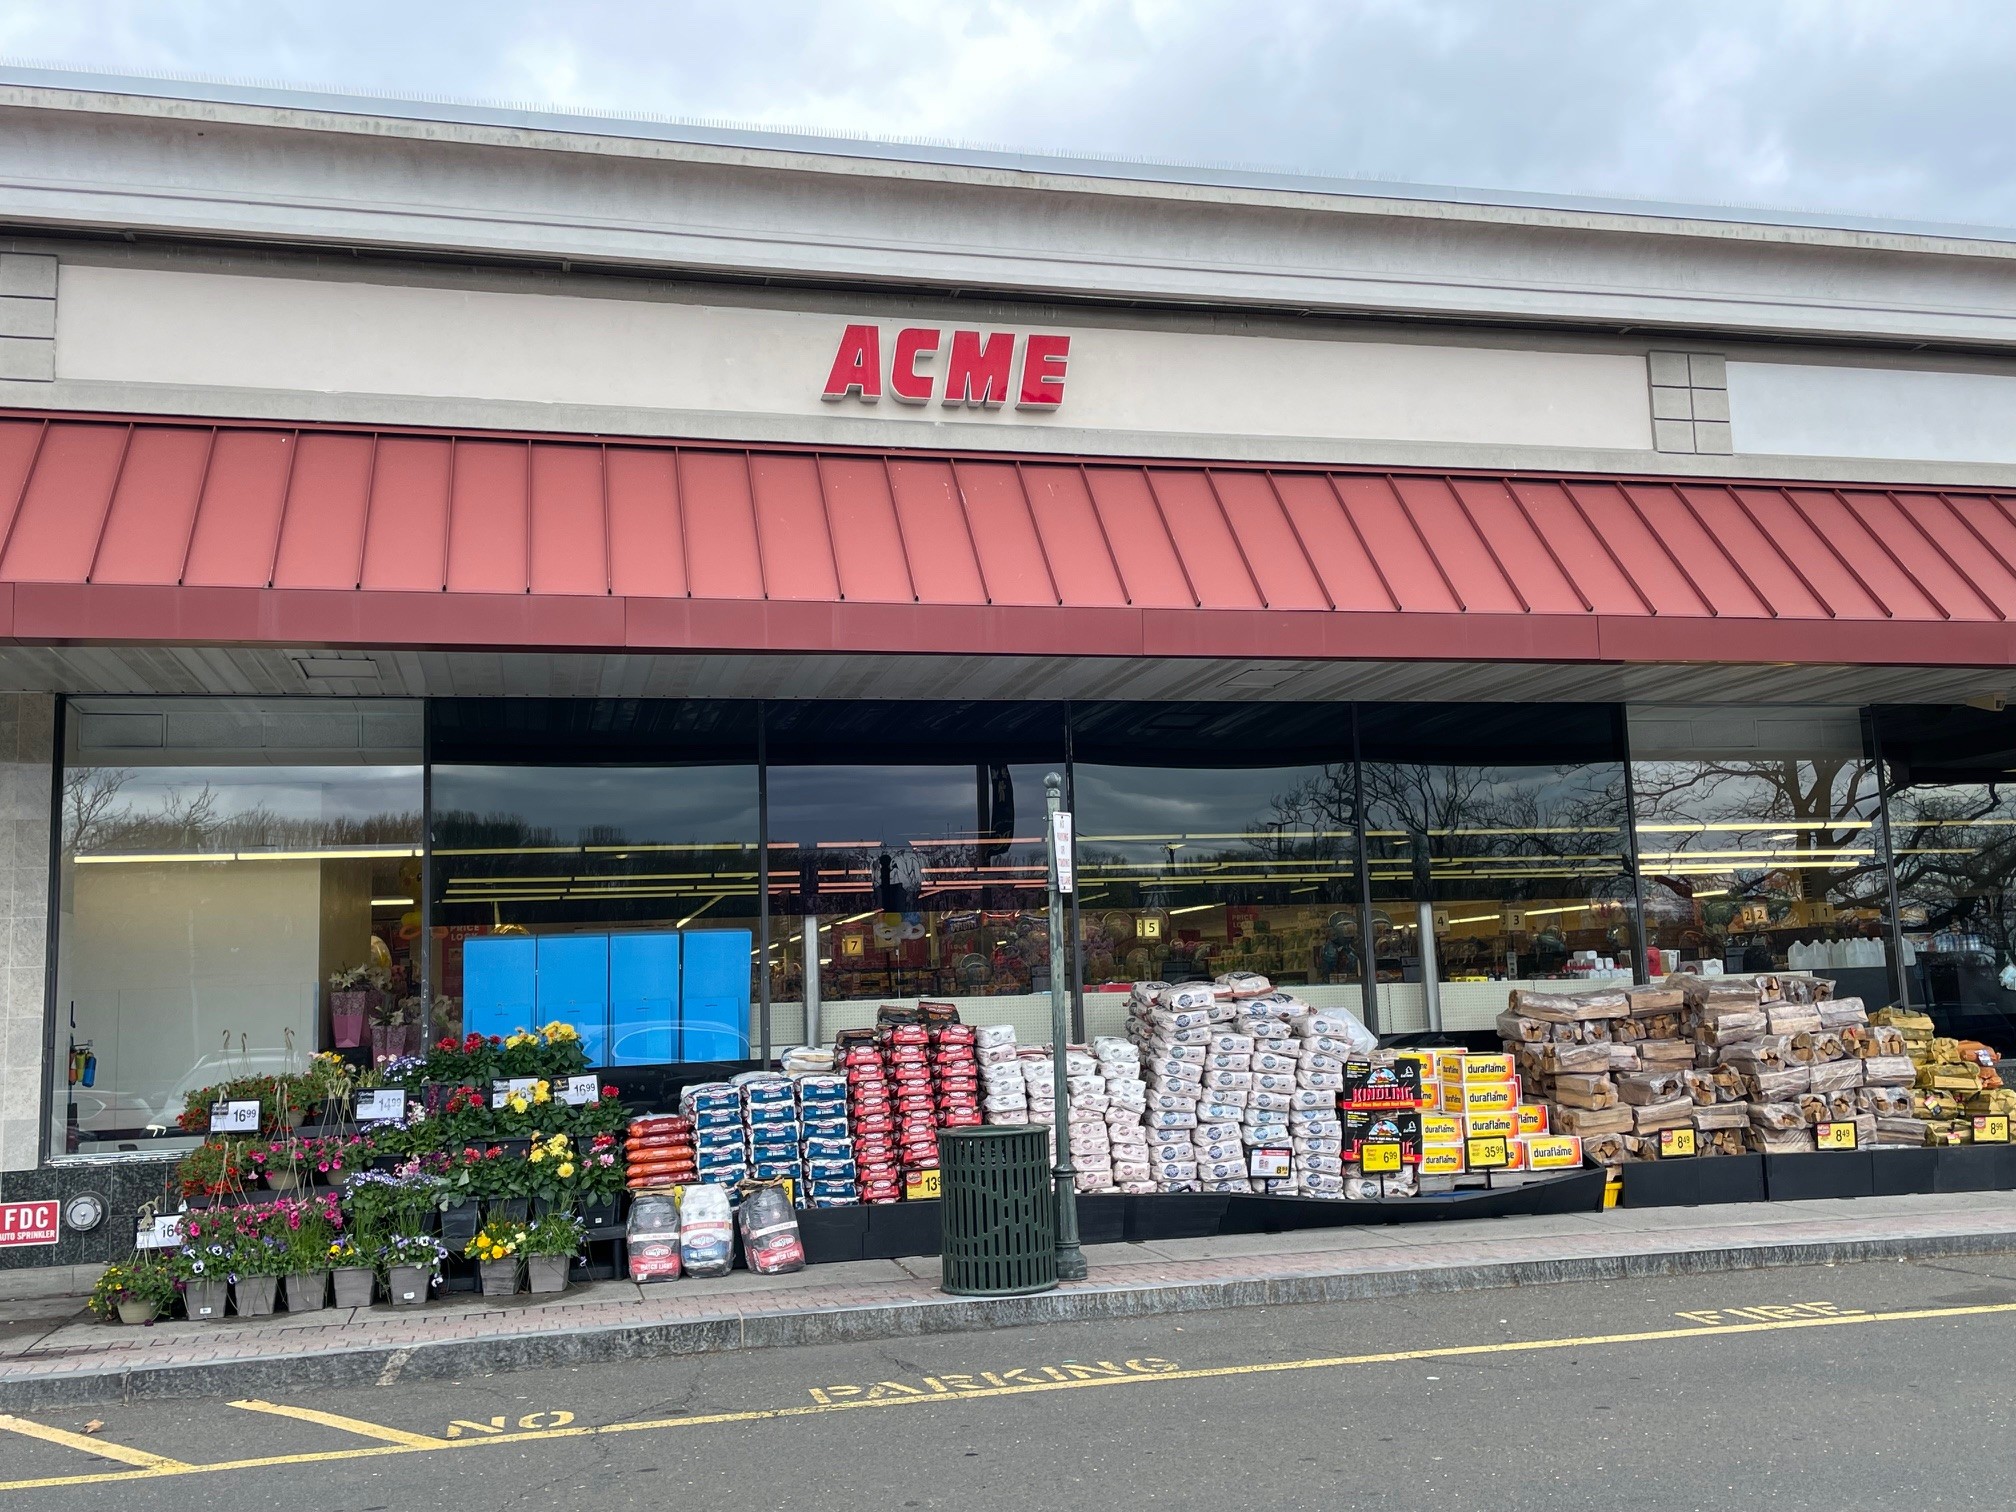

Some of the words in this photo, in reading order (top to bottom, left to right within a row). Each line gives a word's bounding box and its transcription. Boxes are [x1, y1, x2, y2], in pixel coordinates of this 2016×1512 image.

[822, 324, 1071, 408] ACME
[1437, 916, 1444, 927] 4
[1513, 914, 1520, 926] 3
[1148, 922, 1155, 933] 5
[850, 940, 858, 951] 7
[1467, 1062, 1506, 1074] duraflame
[1352, 1086, 1414, 1103] KINDLING
[1469, 1090, 1508, 1103] duraflame
[1424, 1123, 1455, 1133] duraflame
[1472, 1118, 1511, 1131] duraflame
[1533, 1145, 1573, 1157] duraflame
[1425, 1153, 1457, 1164] duraflame
[4, 1206, 49, 1231] FDC
[17, 1229, 55, 1241] SPRINKLER
[808, 1357, 1180, 1404] PARKING
[446, 1410, 575, 1438] NO
